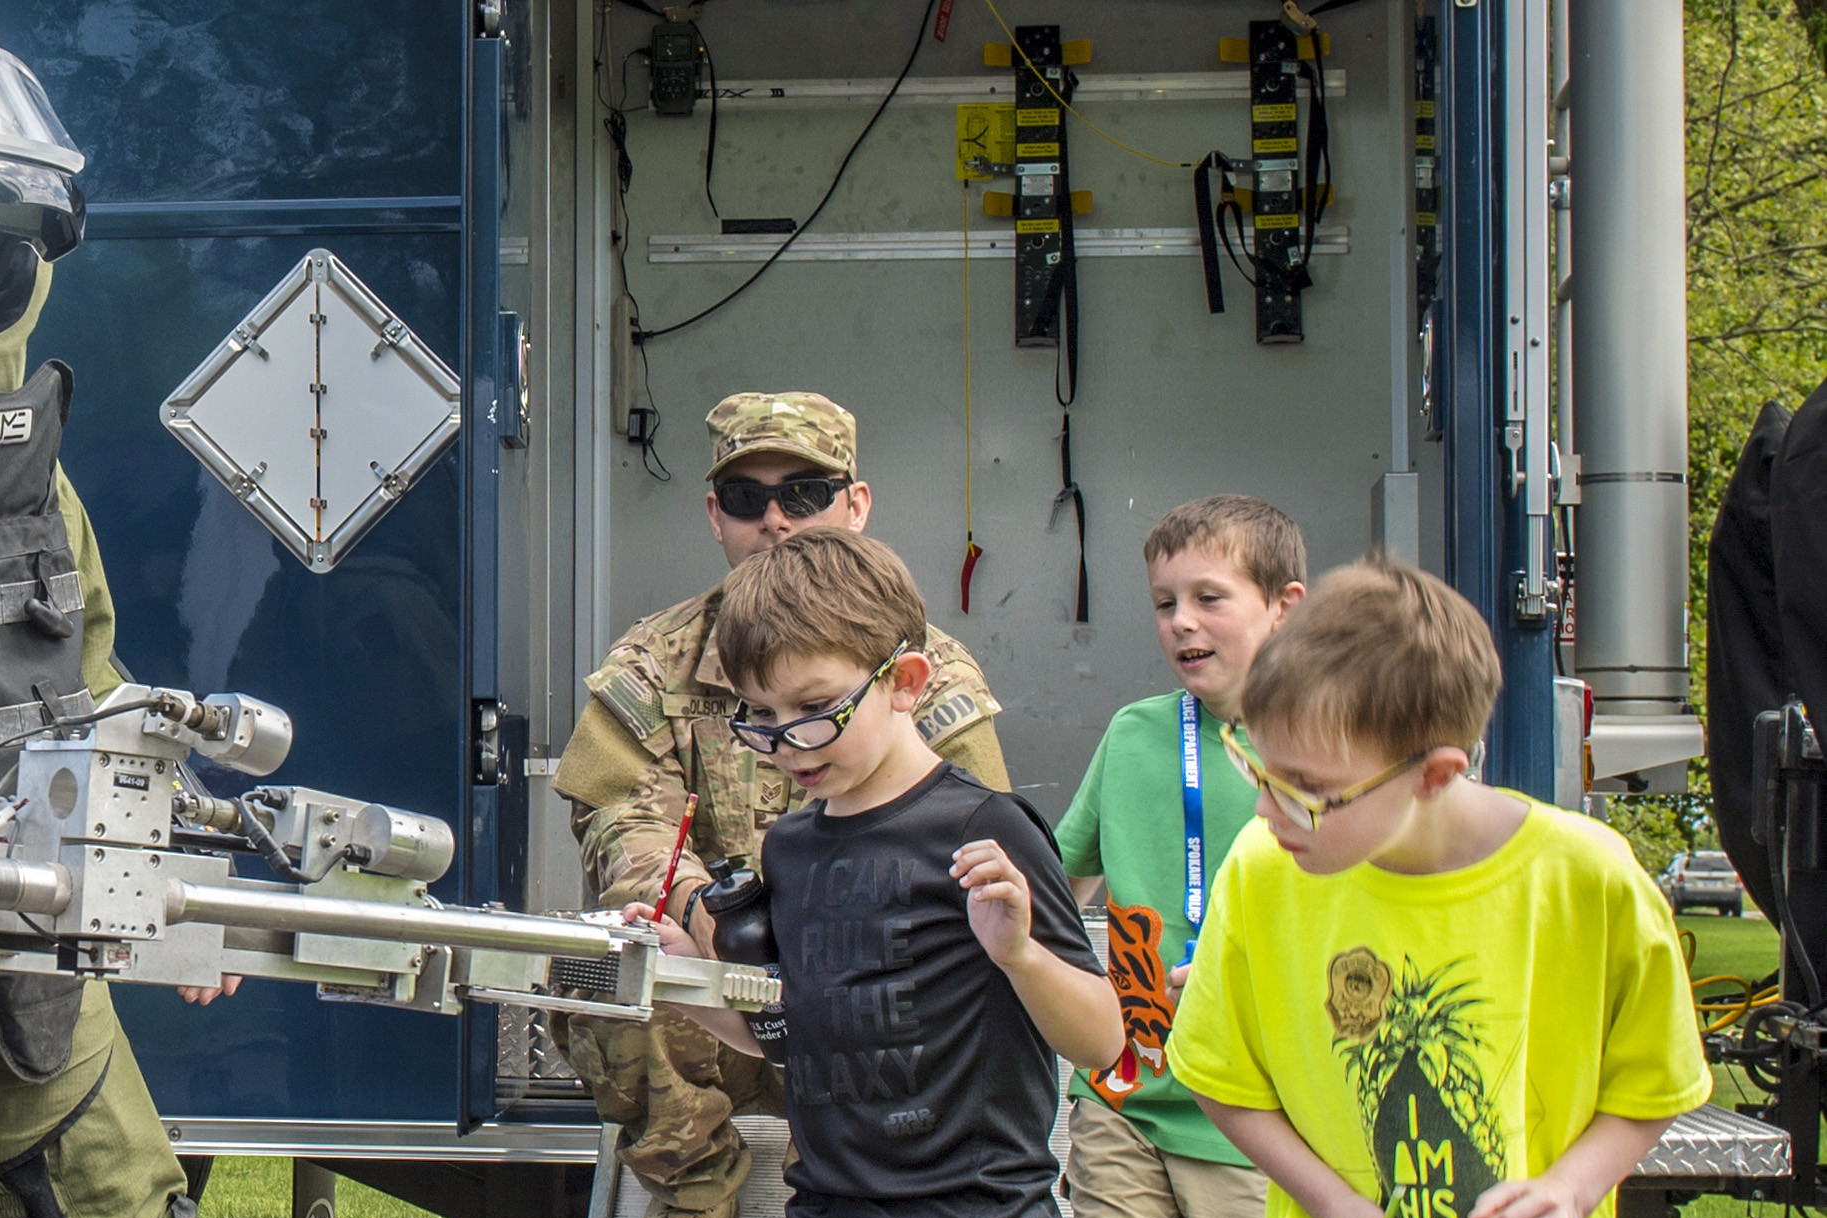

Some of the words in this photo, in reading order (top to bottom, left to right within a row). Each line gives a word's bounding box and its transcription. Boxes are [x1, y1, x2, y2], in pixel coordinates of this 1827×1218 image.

[689, 699, 727, 715] OLSON
[918, 692, 977, 741] EOD
[1182, 691, 1195, 722] OLICE
[1182, 723, 1198, 790] DEPARTMENT
[828, 858, 918, 908] CAN
[1187, 837, 1201, 887] SPOKANE
[801, 919, 916, 974] RULE
[824, 980, 920, 1037] THE
[886, 1109, 932, 1124] STAR
[1407, 1093, 1418, 1140] I
[1393, 1139, 1454, 1185] AM
